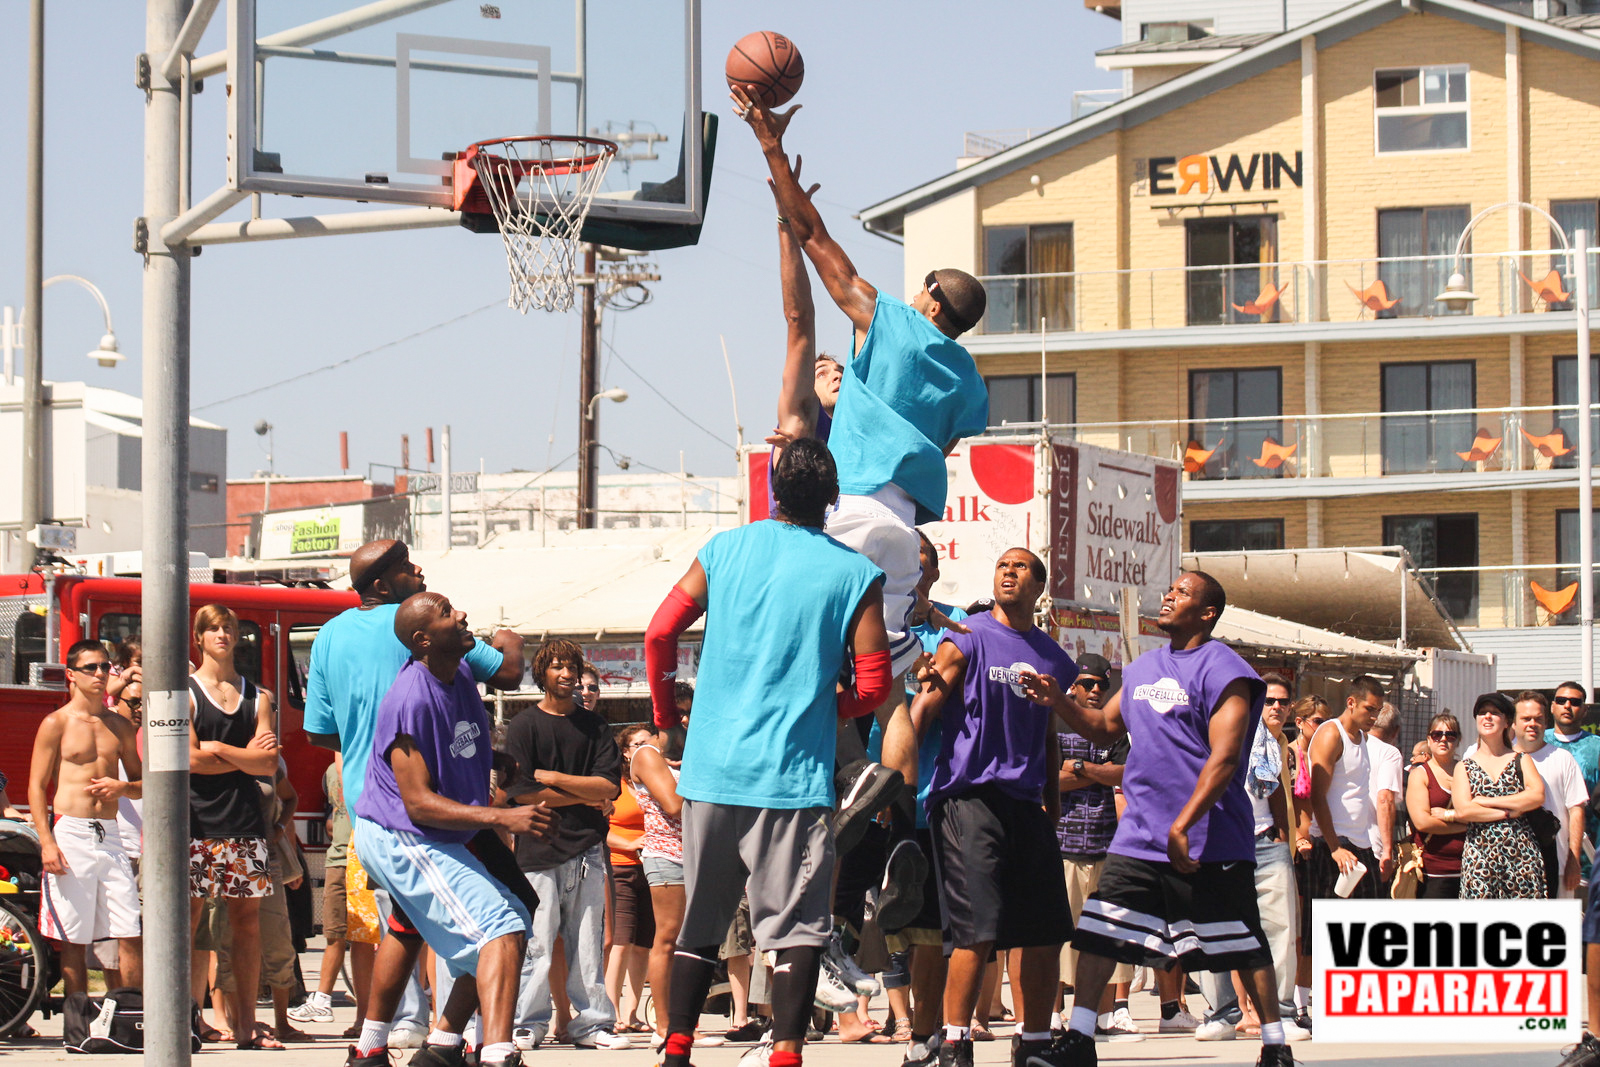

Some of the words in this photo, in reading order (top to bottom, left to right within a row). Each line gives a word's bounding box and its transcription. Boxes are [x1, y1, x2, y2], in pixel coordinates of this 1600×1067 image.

[1149, 150, 1303, 196] ERWIN
[292, 522, 338, 537] Fashion
[1057, 453, 1071, 587] VENICE
[1086, 500, 1162, 546] Sidewalk
[291, 537, 337, 553] Factory
[1085, 544, 1148, 587] Market
[991, 668, 1020, 683] VENICE
